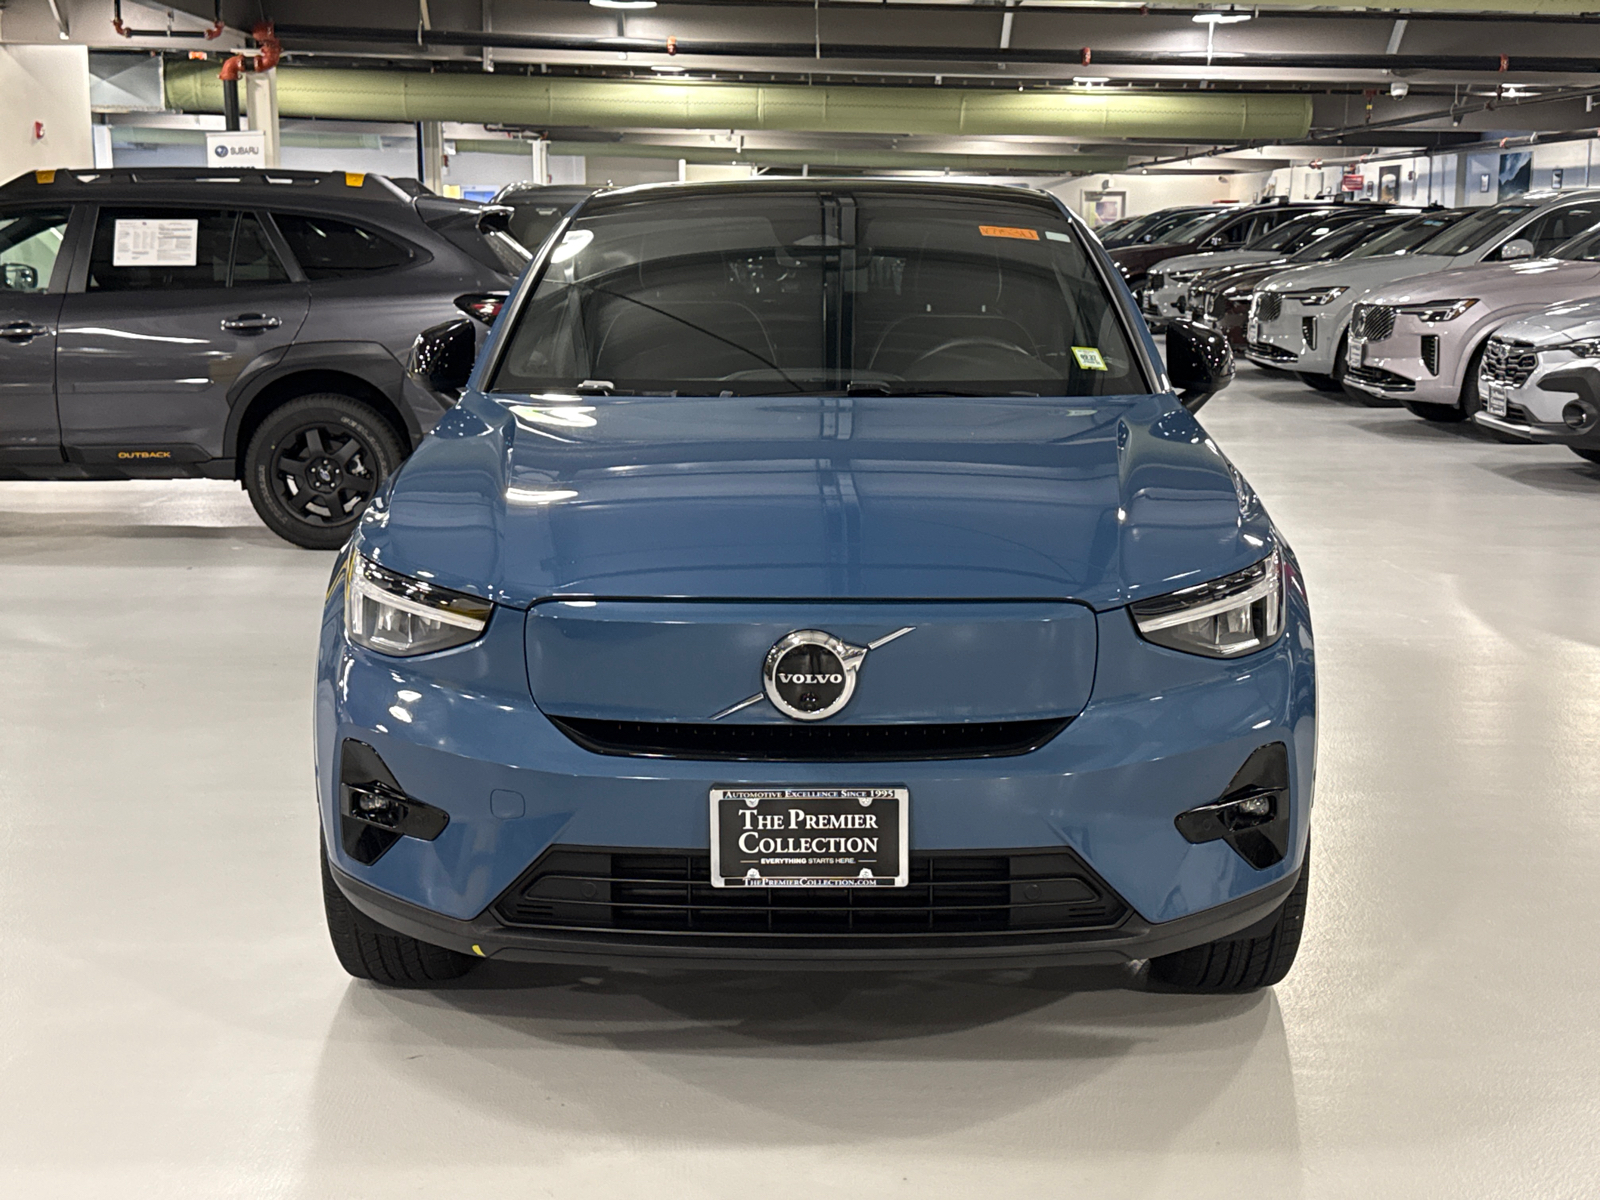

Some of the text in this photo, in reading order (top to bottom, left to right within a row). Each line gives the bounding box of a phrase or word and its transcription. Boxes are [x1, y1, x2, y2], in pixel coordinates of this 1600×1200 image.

[230, 146, 259, 155] SUBARU
[118, 451, 171, 459] OUTBACK
[777, 673, 843, 684] VOLVO
[725, 790, 782, 799] AUTOMOTIVE
[840, 789, 867, 798] SINCE
[870, 789, 894, 798] 1995
[738, 808, 879, 830] THE PREMIER
[738, 831, 879, 854] COLLECTION
[760, 857, 807, 865] EVERYTHING
[808, 857, 834, 865] STARTS
